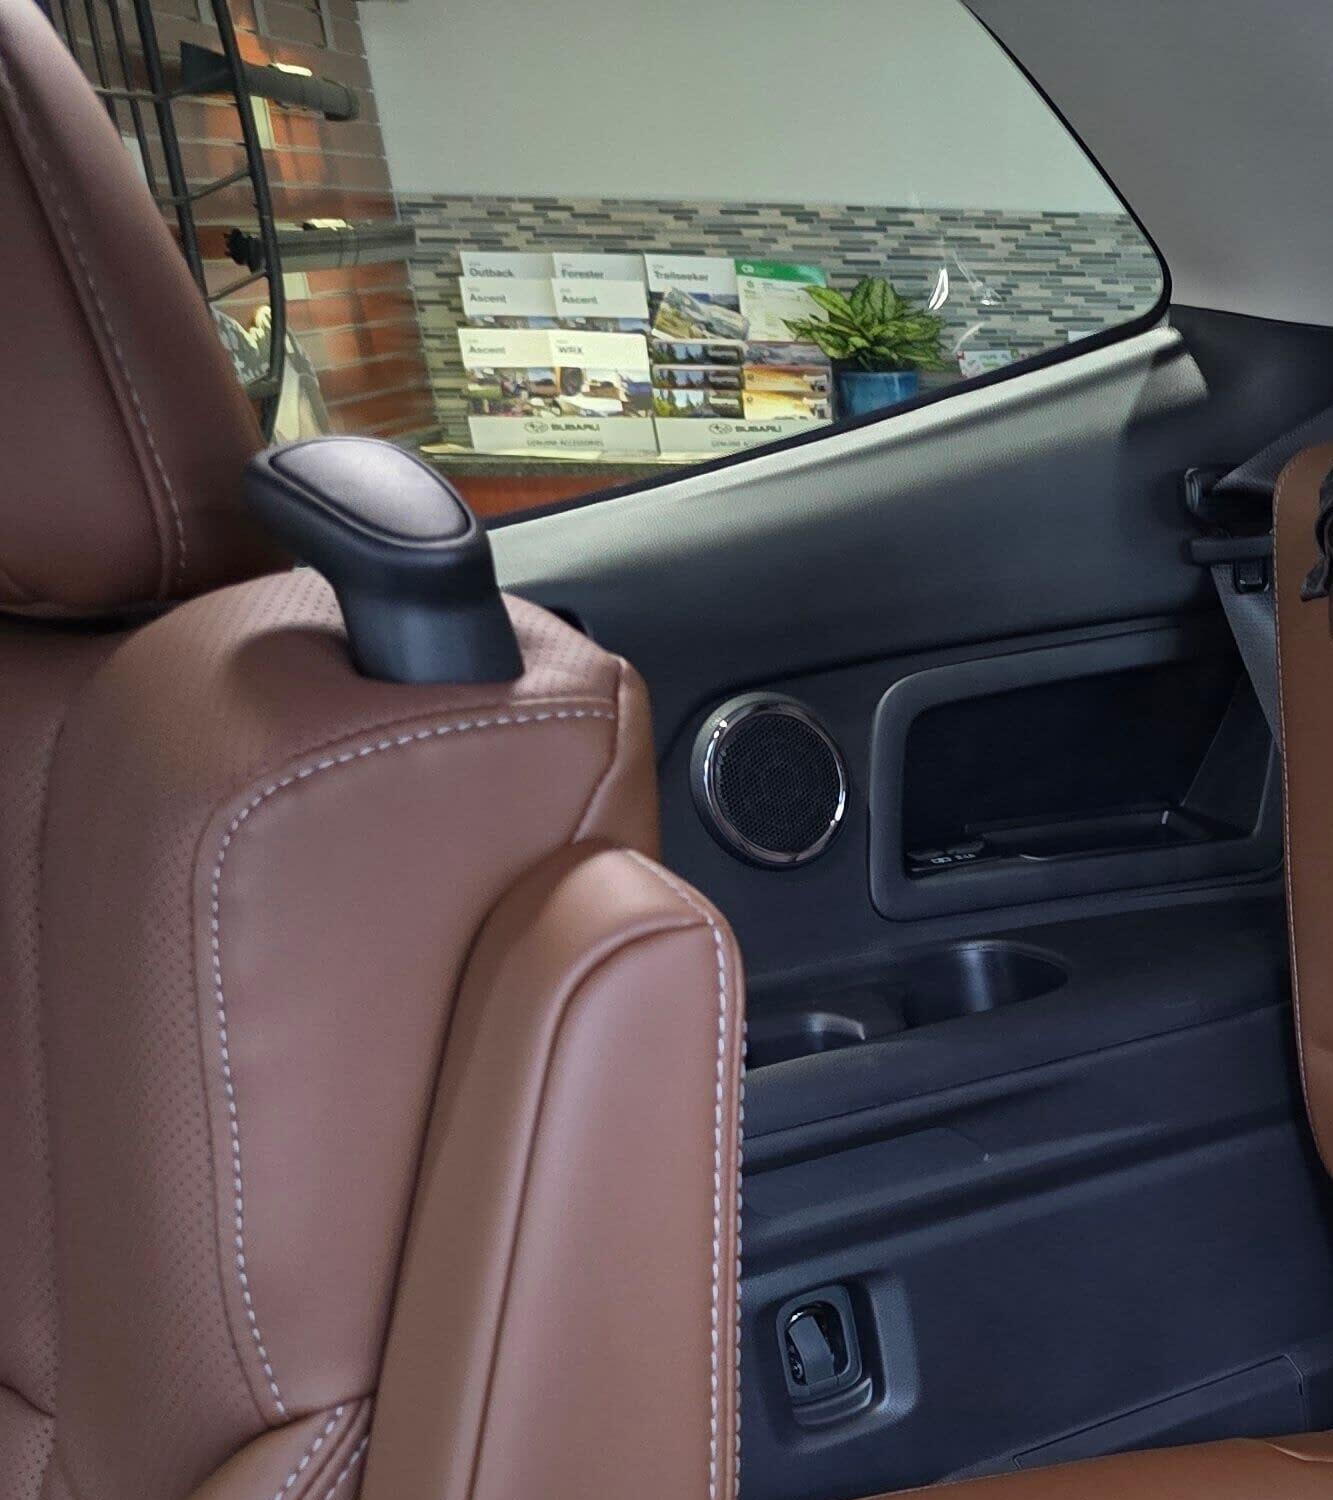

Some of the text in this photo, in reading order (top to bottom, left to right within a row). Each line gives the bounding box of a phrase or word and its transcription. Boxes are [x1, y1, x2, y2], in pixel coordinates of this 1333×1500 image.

[469, 267, 514, 278] Outback
[561, 269, 605, 280] Forester
[654, 270, 709, 281] Trailseeker
[469, 293, 507, 304] Ascent
[561, 294, 598, 304] Ascent
[468, 345, 506, 355] Ascent
[558, 345, 584, 355] WRX
[550, 423, 600, 433] SUBARU
[735, 425, 782, 433] SUBARU
